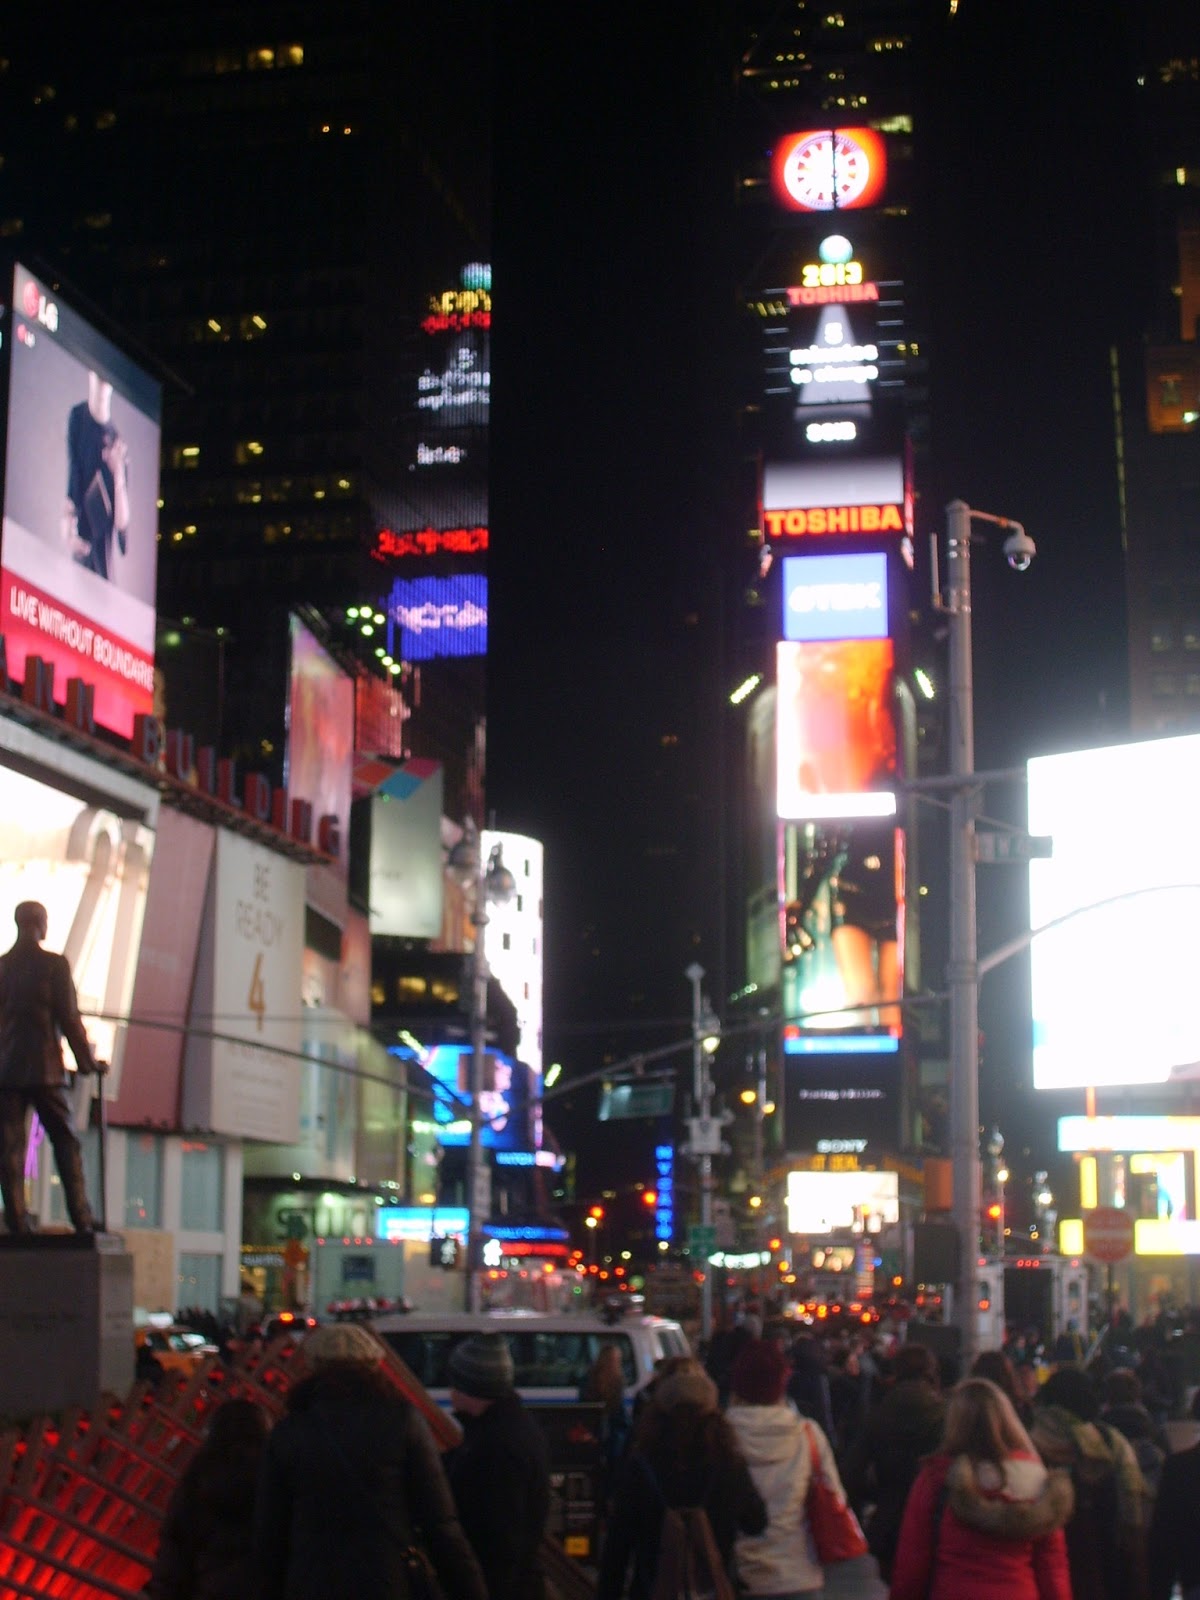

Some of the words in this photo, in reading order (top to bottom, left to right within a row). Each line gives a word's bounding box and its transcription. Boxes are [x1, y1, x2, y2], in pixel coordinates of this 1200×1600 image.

[787, 282, 879, 305] TOSHIBA
[764, 503, 903, 537] TOSHIBA
[9, 585, 39, 627] LIVE
[38, 600, 95, 657] WITHOUT
[130, 711, 341, 858] BUILDING
[816, 1138, 868, 1154] SONY
